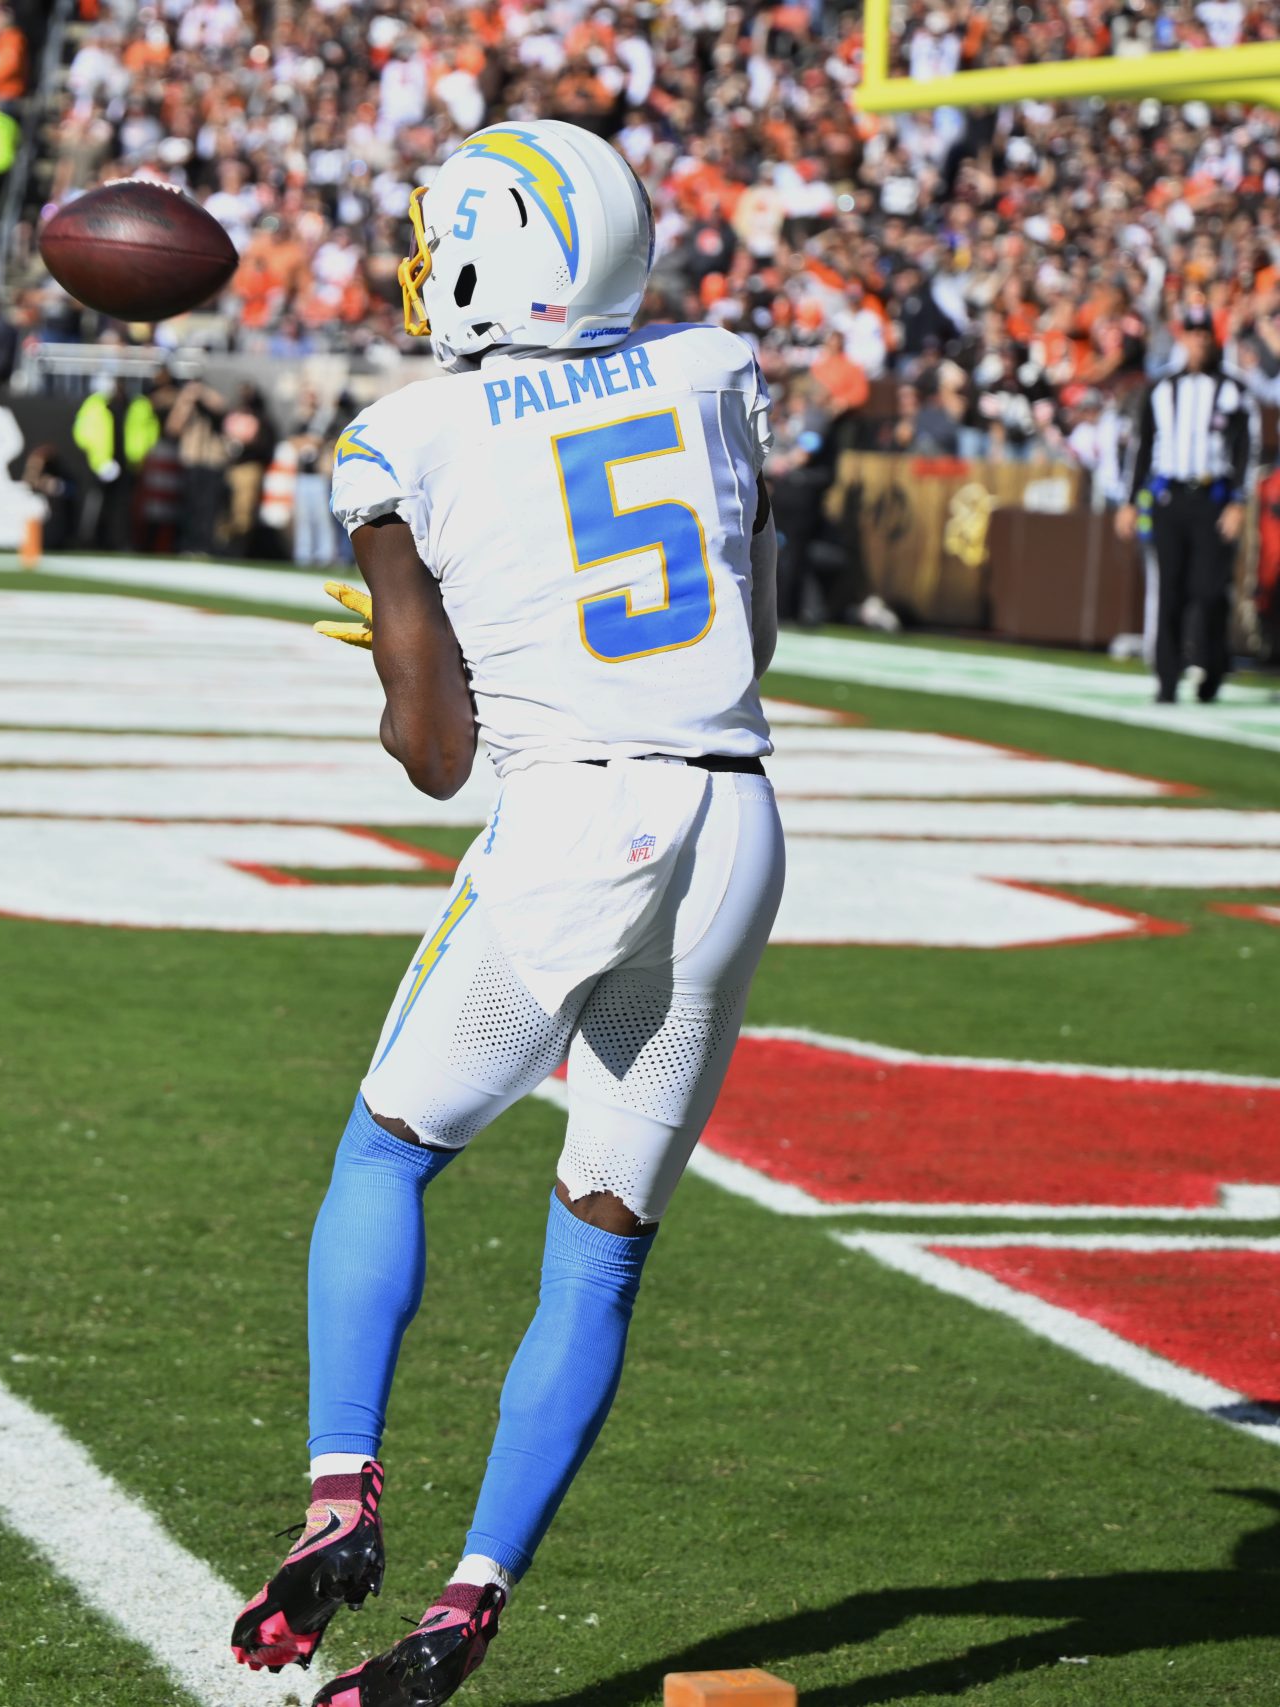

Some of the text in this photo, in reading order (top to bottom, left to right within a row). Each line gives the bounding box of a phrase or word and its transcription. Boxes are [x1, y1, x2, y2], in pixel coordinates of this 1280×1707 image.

[453, 189, 486, 240] 5
[483, 346, 657, 426] PALMER
[550, 407, 716, 664] 5
[629, 847, 650, 862] NFL
